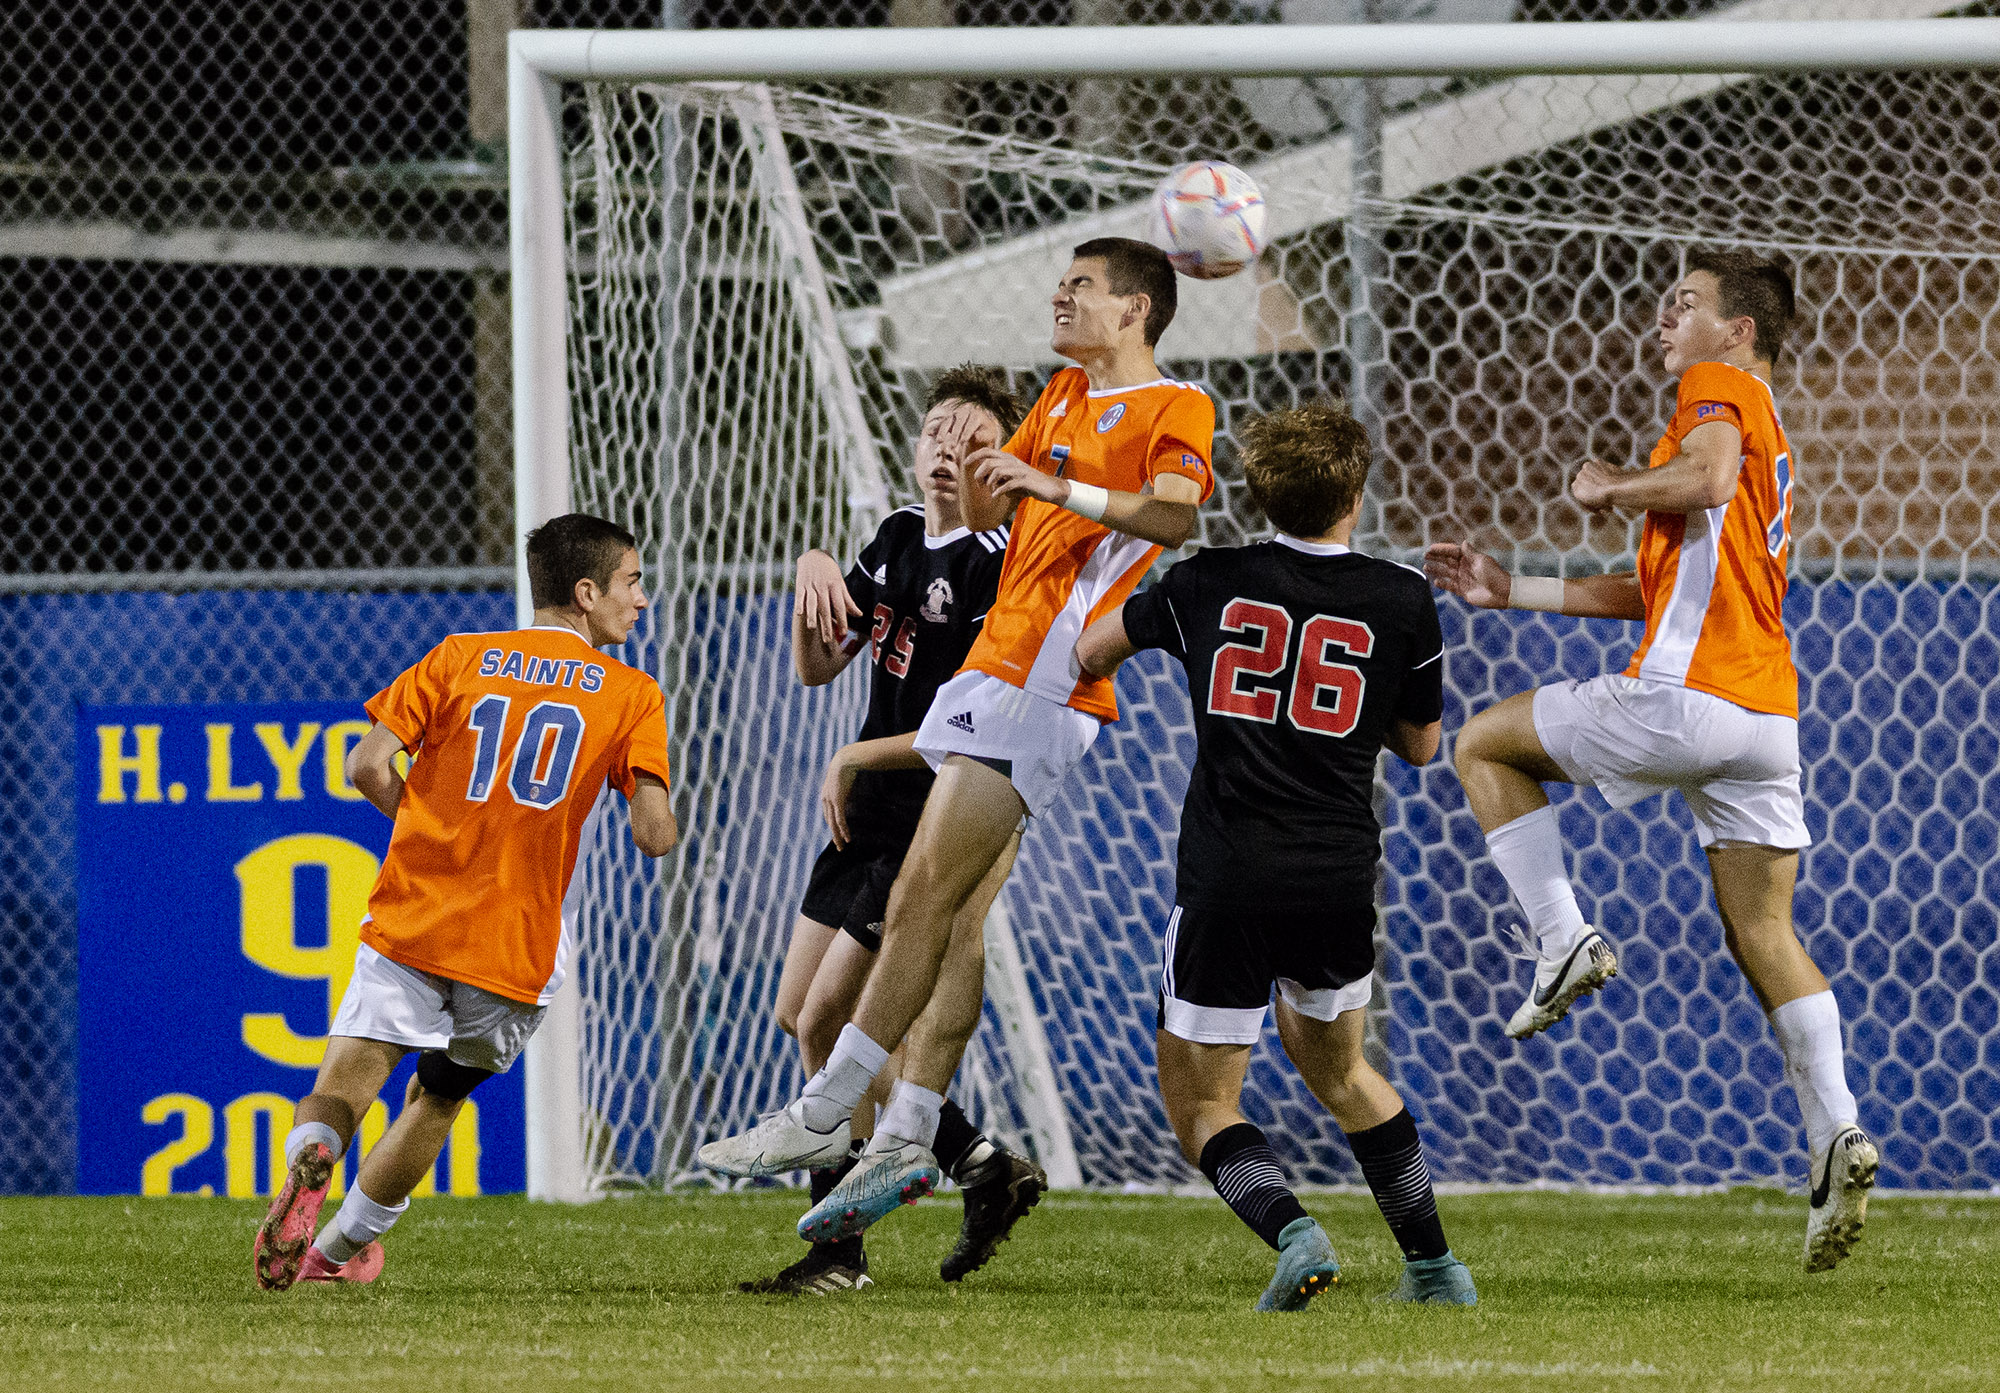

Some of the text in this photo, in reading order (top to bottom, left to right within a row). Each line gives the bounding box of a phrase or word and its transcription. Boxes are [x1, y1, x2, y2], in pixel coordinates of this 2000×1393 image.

[1050, 443, 1071, 478] 7
[478, 648, 606, 694] SAINTS
[871, 602, 917, 679] 25
[1207, 597, 1375, 738] 26
[96, 720, 418, 803] H. LYO
[465, 693, 586, 811] 10
[946, 717, 976, 734] adidas
[233, 833, 382, 1070] 9
[822, 1151, 908, 1211] NIKE
